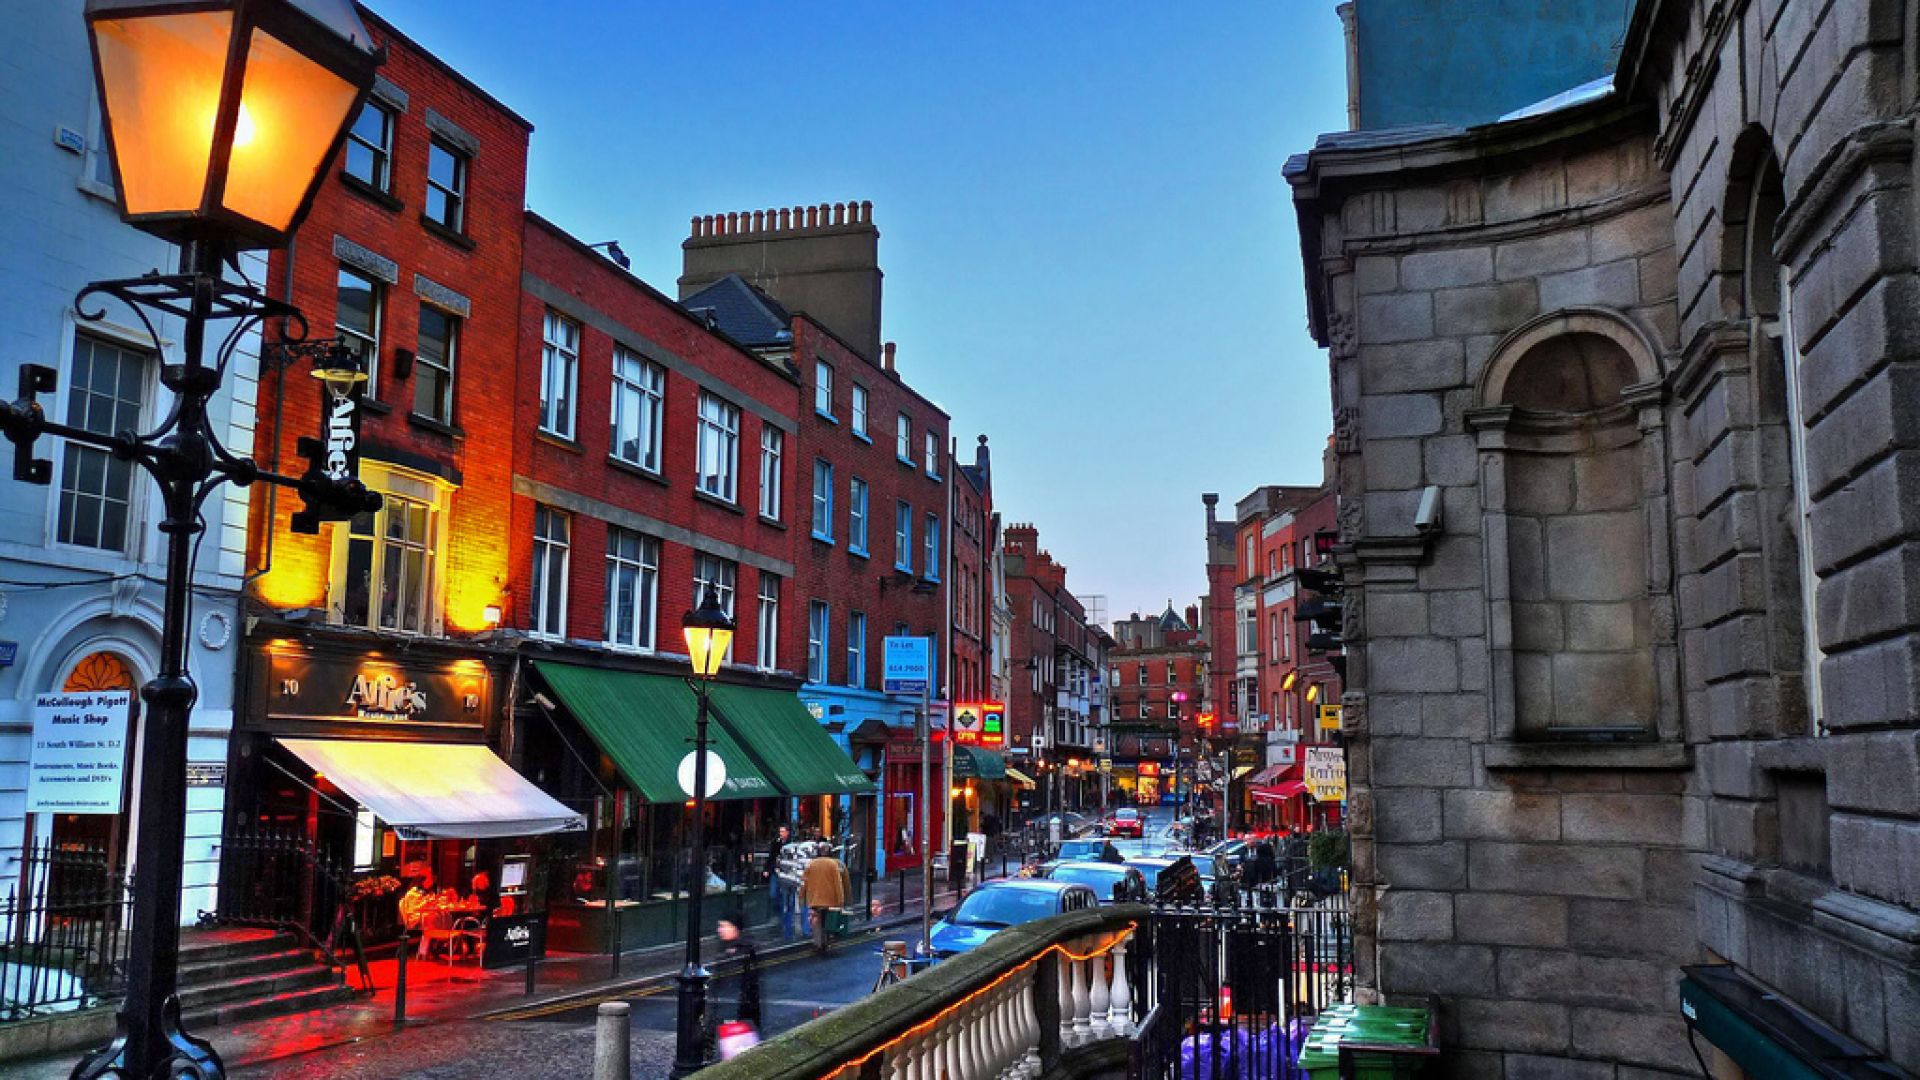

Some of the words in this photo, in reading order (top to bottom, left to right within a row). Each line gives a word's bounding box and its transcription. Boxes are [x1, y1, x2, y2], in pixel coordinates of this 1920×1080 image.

[37, 696, 93, 709] McCullough
[97, 695, 128, 709] Pigott
[52, 714, 80, 725] Music
[83, 713, 109, 726] Shop
